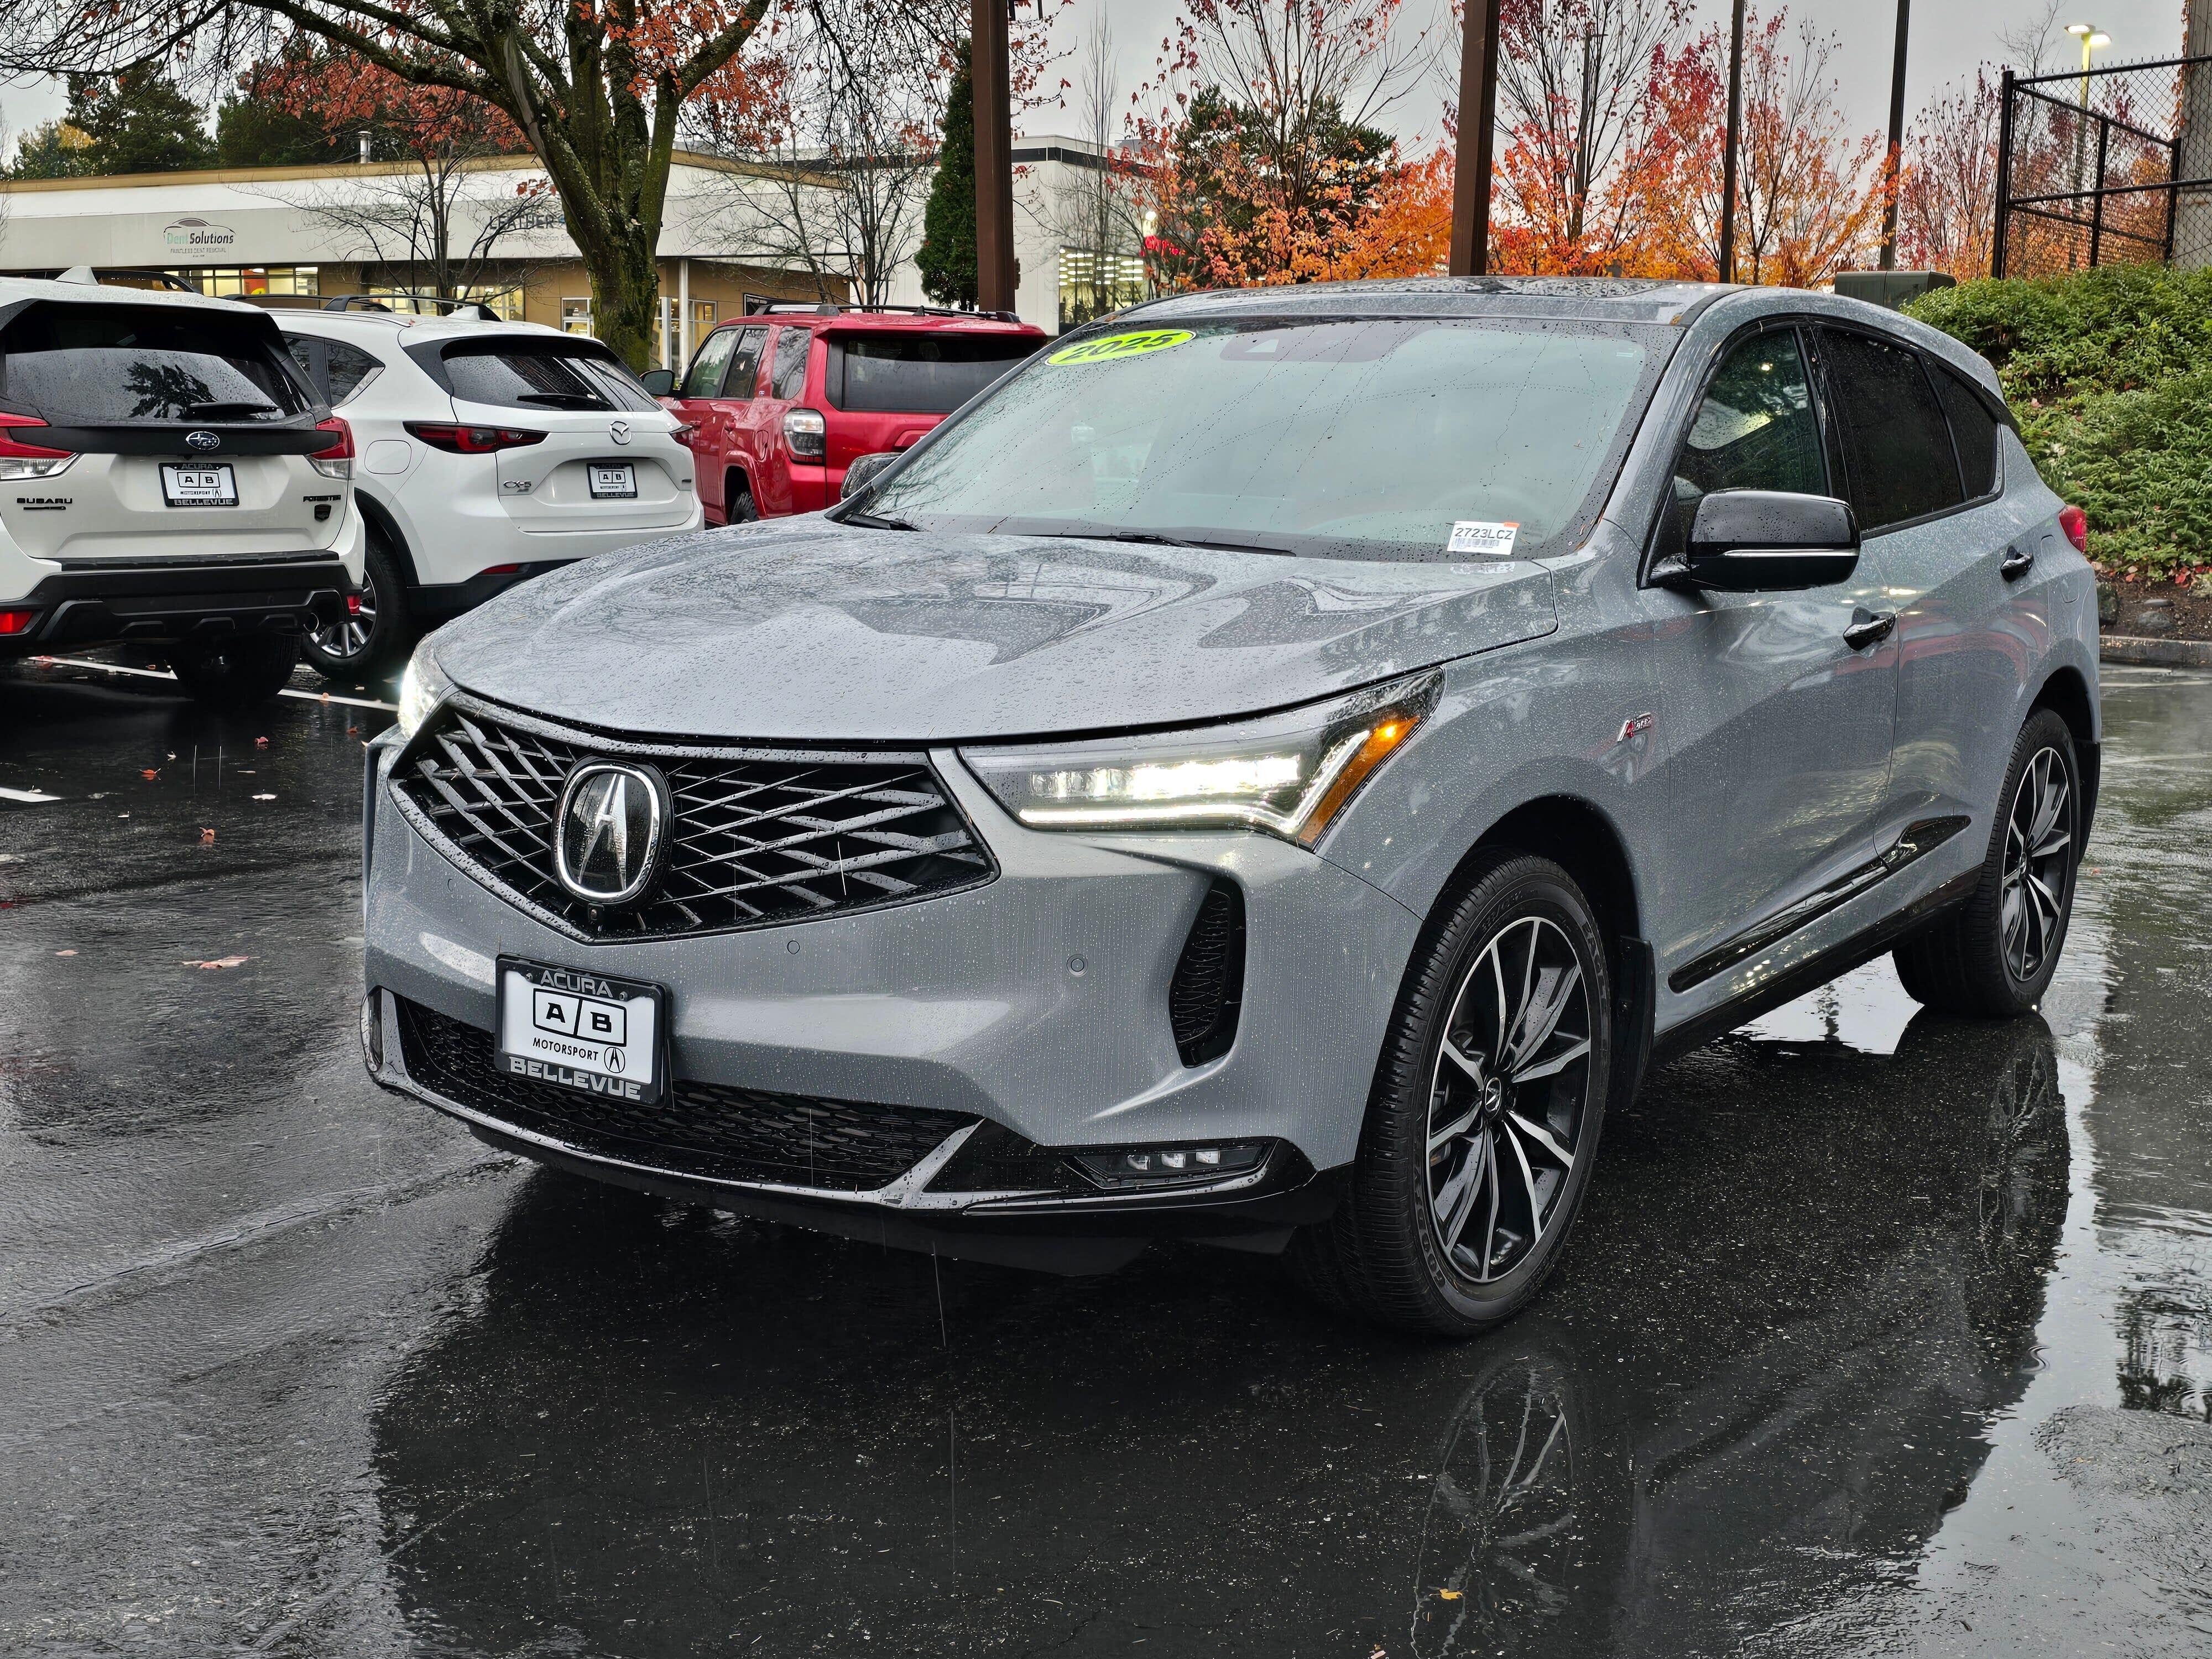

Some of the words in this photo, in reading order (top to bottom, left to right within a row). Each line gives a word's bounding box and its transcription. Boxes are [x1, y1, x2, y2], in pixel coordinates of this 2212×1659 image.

[489, 214, 554, 229] LEATHER
[190, 231, 233, 244] Solutions
[1058, 332, 1183, 363] 2025
[503, 480, 531, 488] CX-5
[1454, 528, 1514, 540] 2723LCZ
[540, 970, 613, 998] ACURA
[546, 1002, 566, 1023] A
[590, 1011, 612, 1032] B
[533, 1037, 598, 1061] MOTORSPORT
[509, 1056, 641, 1100] BELLEVUE
